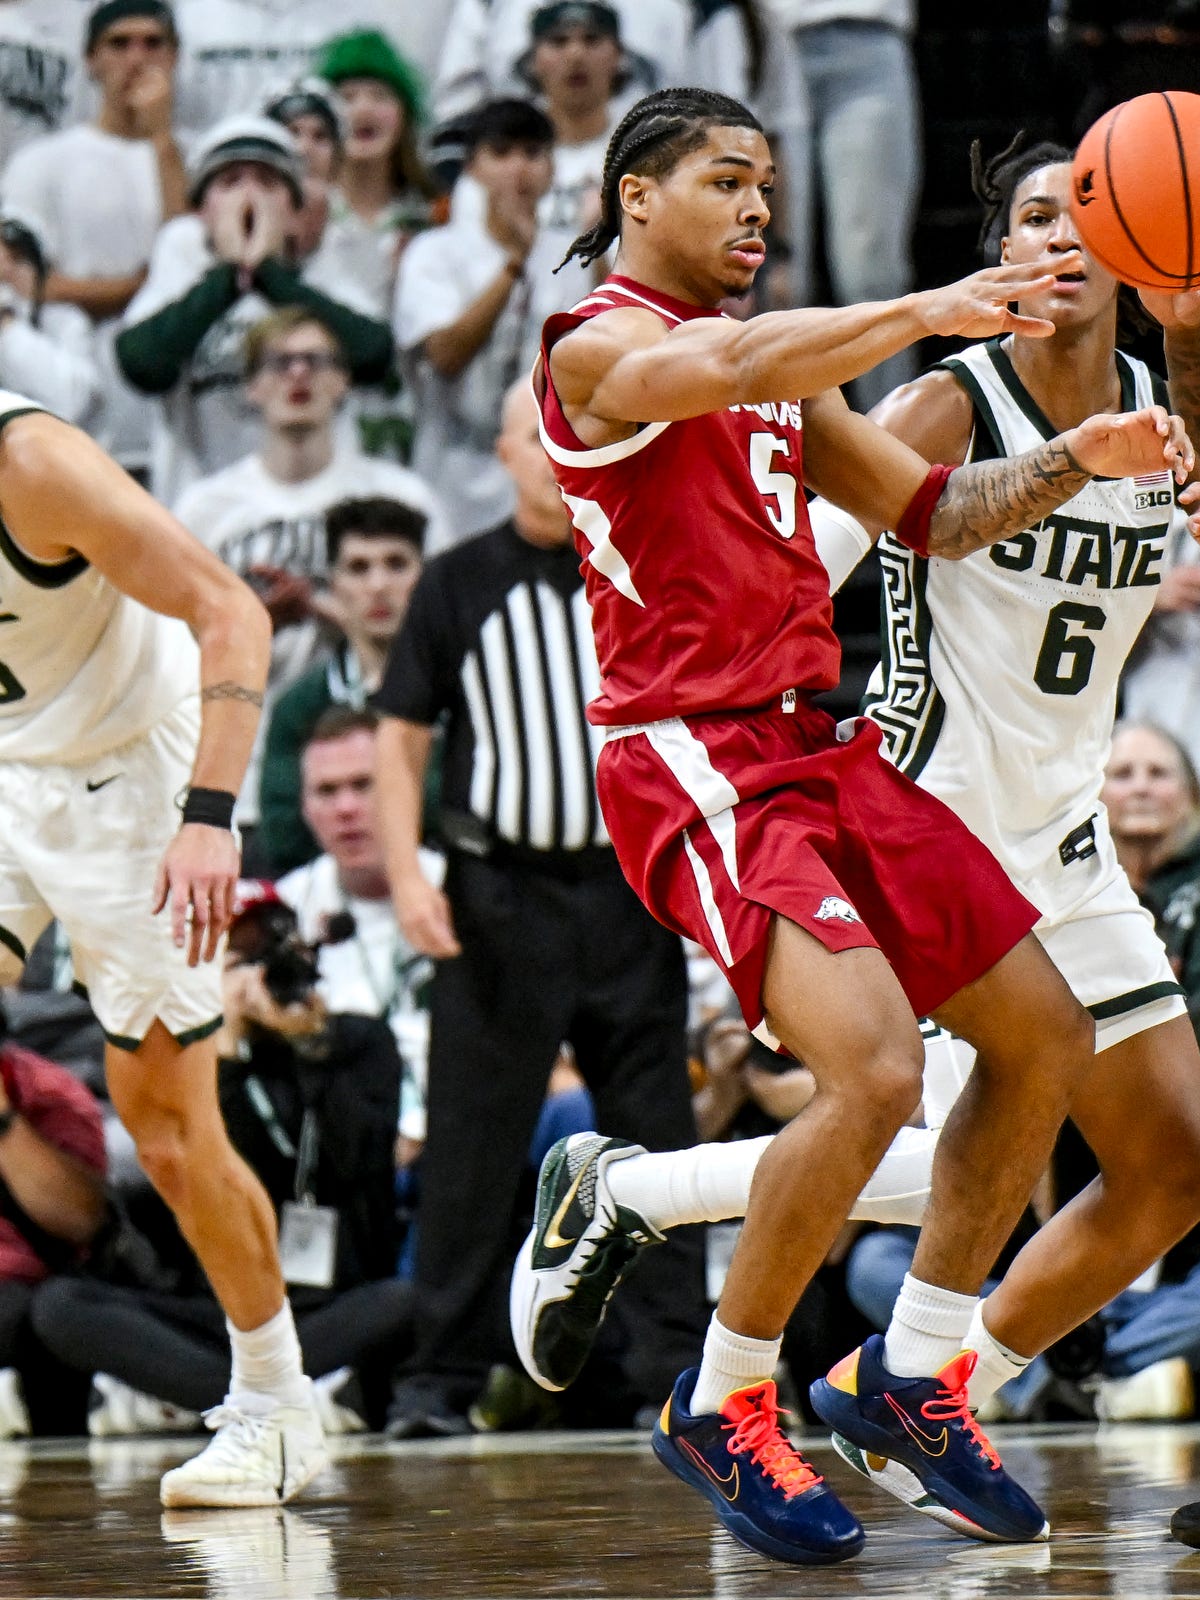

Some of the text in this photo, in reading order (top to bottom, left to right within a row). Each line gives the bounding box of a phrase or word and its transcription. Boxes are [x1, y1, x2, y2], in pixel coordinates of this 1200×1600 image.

[750, 432, 797, 539] 5
[989, 513, 1169, 590] STATE
[1033, 600, 1107, 696] 6
